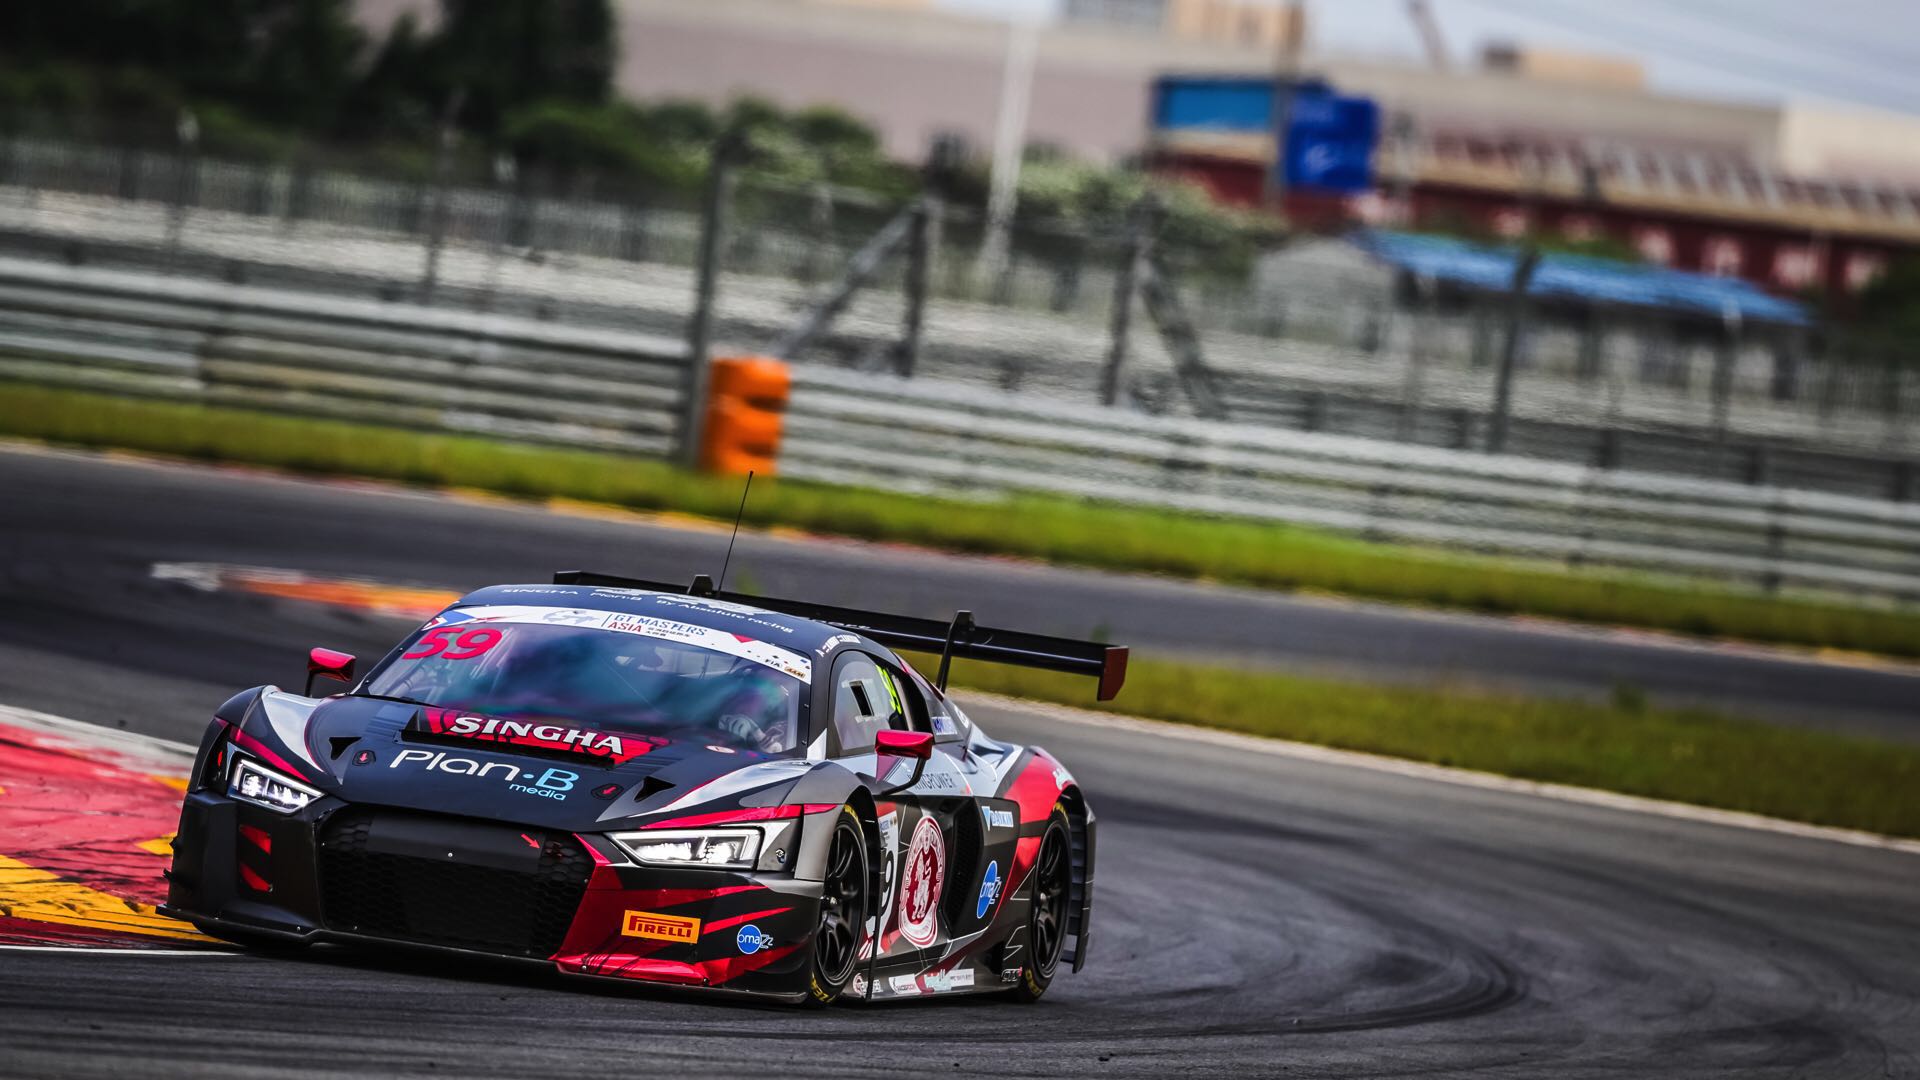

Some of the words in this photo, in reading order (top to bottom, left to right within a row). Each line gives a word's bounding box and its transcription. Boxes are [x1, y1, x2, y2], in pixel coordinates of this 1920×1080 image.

[608, 621, 642, 633] ASIA
[614, 614, 636, 622] GT
[637, 617, 708, 636] MASTERS
[402, 627, 503, 660] 59
[449, 716, 624, 755] SINGHA
[509, 783, 568, 801] media
[628, 915, 694, 938] PIRELLI
